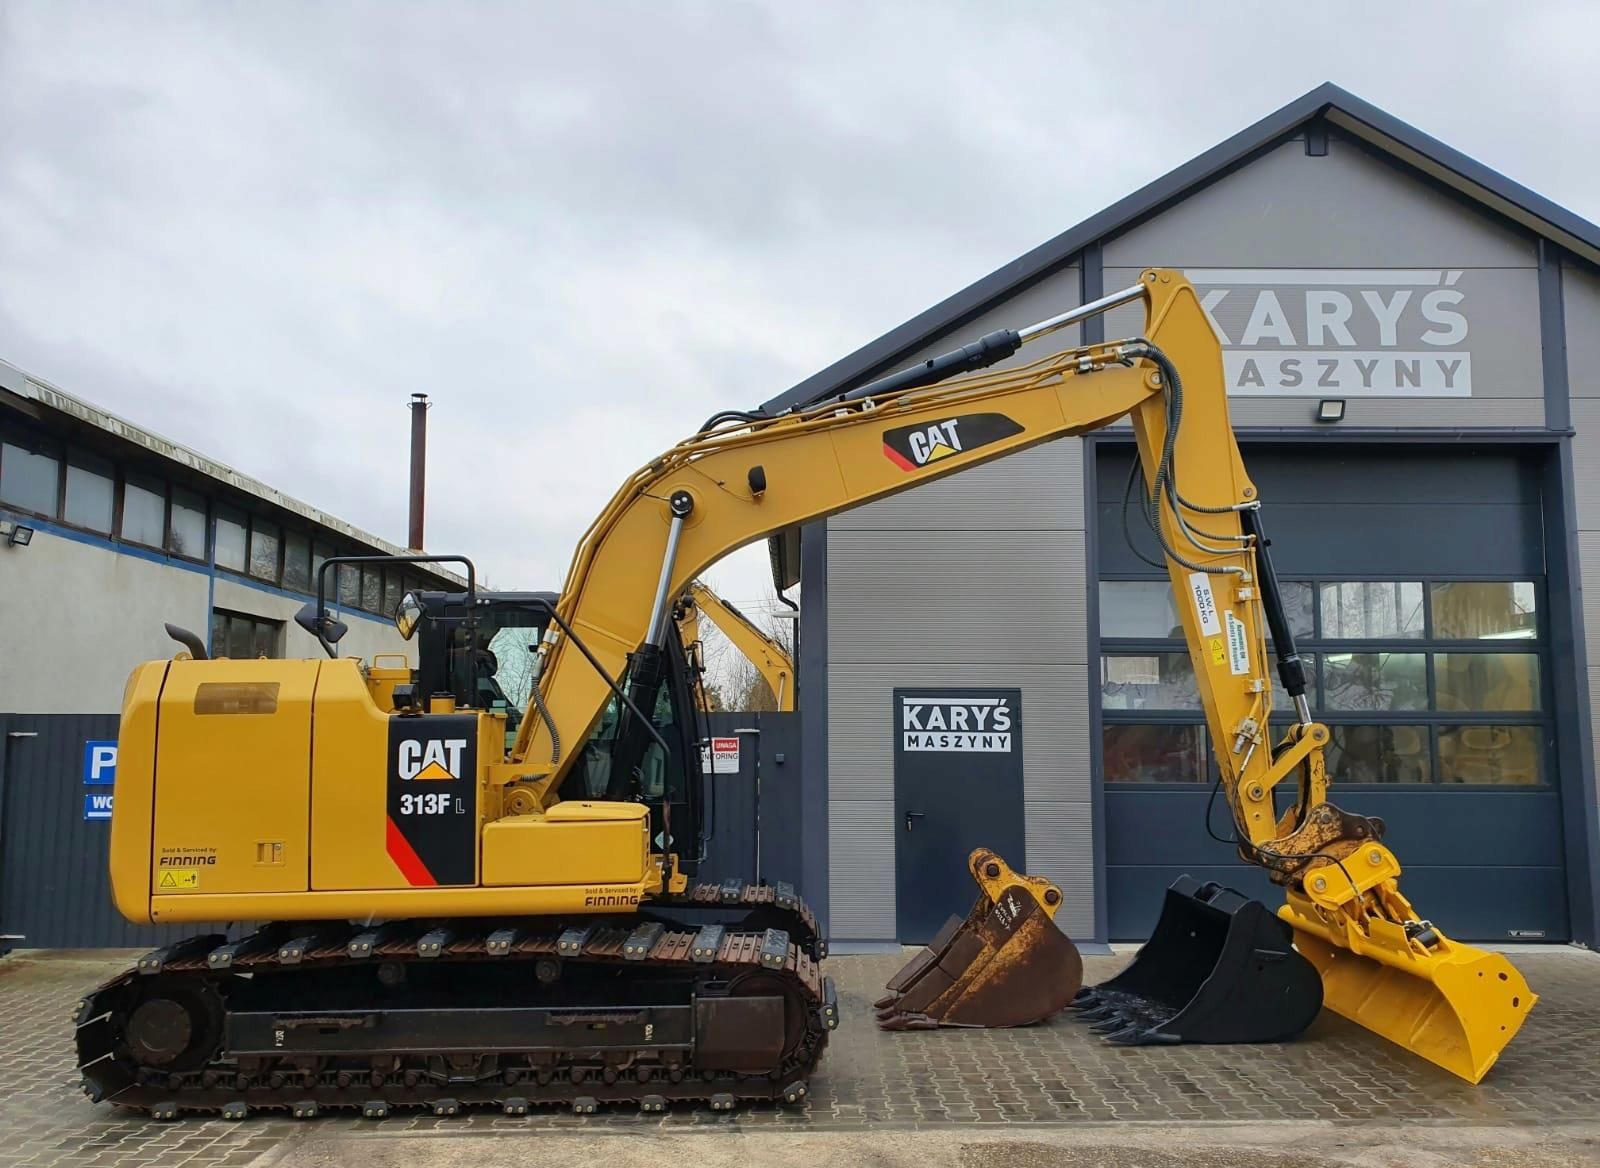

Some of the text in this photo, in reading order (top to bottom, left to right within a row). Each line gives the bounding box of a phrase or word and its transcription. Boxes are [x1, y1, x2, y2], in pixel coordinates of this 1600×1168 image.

[1236, 359, 1462, 387] ASZYNY
[908, 418, 962, 464] CAT
[903, 698, 1011, 731] KARYŚ
[907, 735, 1008, 749] MASZYNY
[91, 746, 118, 779] P
[399, 739, 467, 780] CAT
[400, 793, 465, 815] 313F L
[160, 856, 217, 866] FINNING
[585, 895, 639, 906] FINNING
